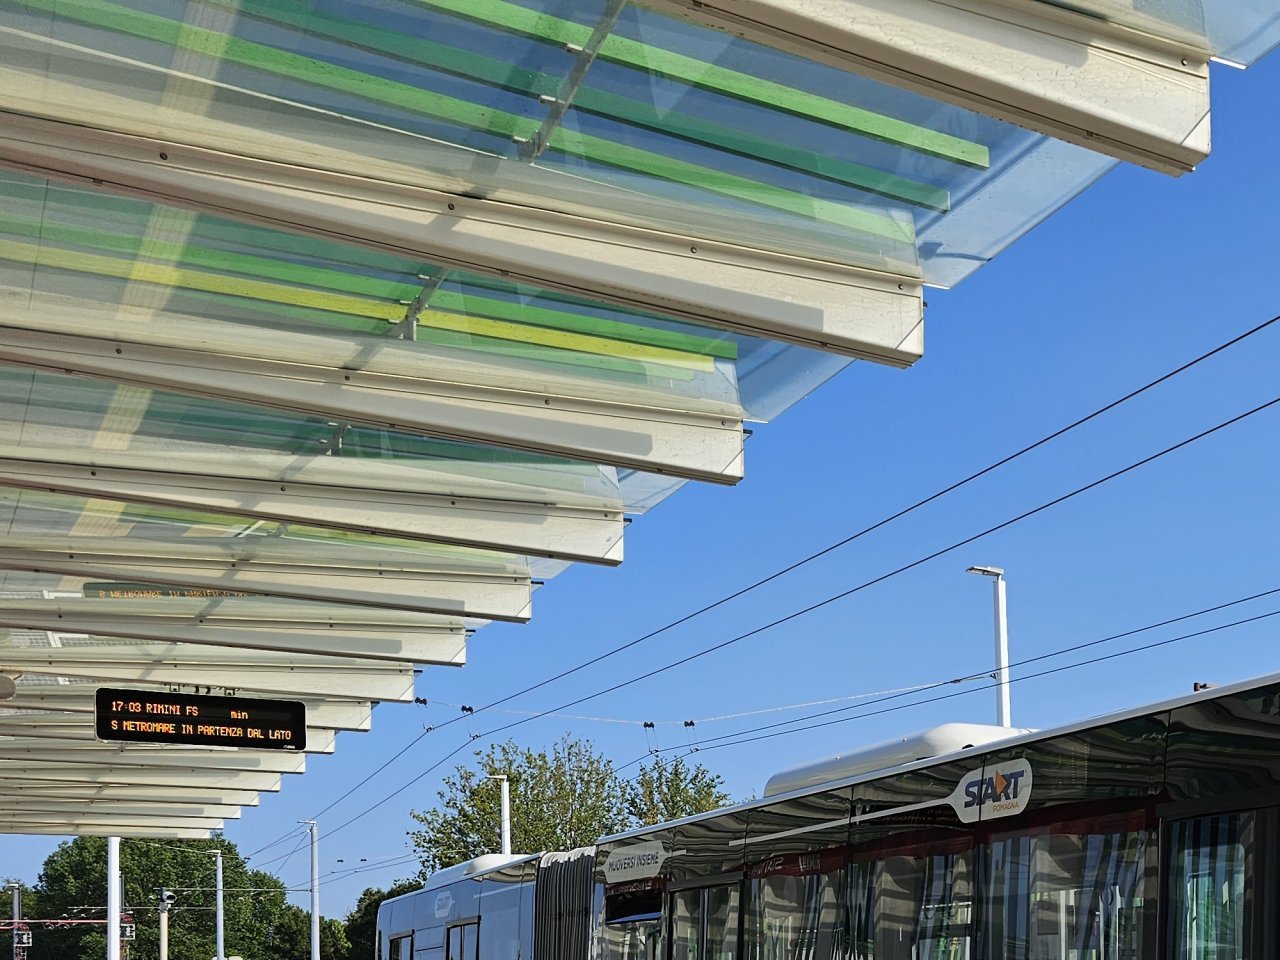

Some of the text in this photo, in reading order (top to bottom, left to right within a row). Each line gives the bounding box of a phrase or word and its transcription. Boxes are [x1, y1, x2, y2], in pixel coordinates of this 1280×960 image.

[111, 701, 249, 720] 17:03 RIMINI FS min
[111, 720, 292, 740] S METROMARE IN PARTENZA DAL LATO
[964, 769, 1026, 809] START
[992, 801, 1020, 813] ROMAGNA
